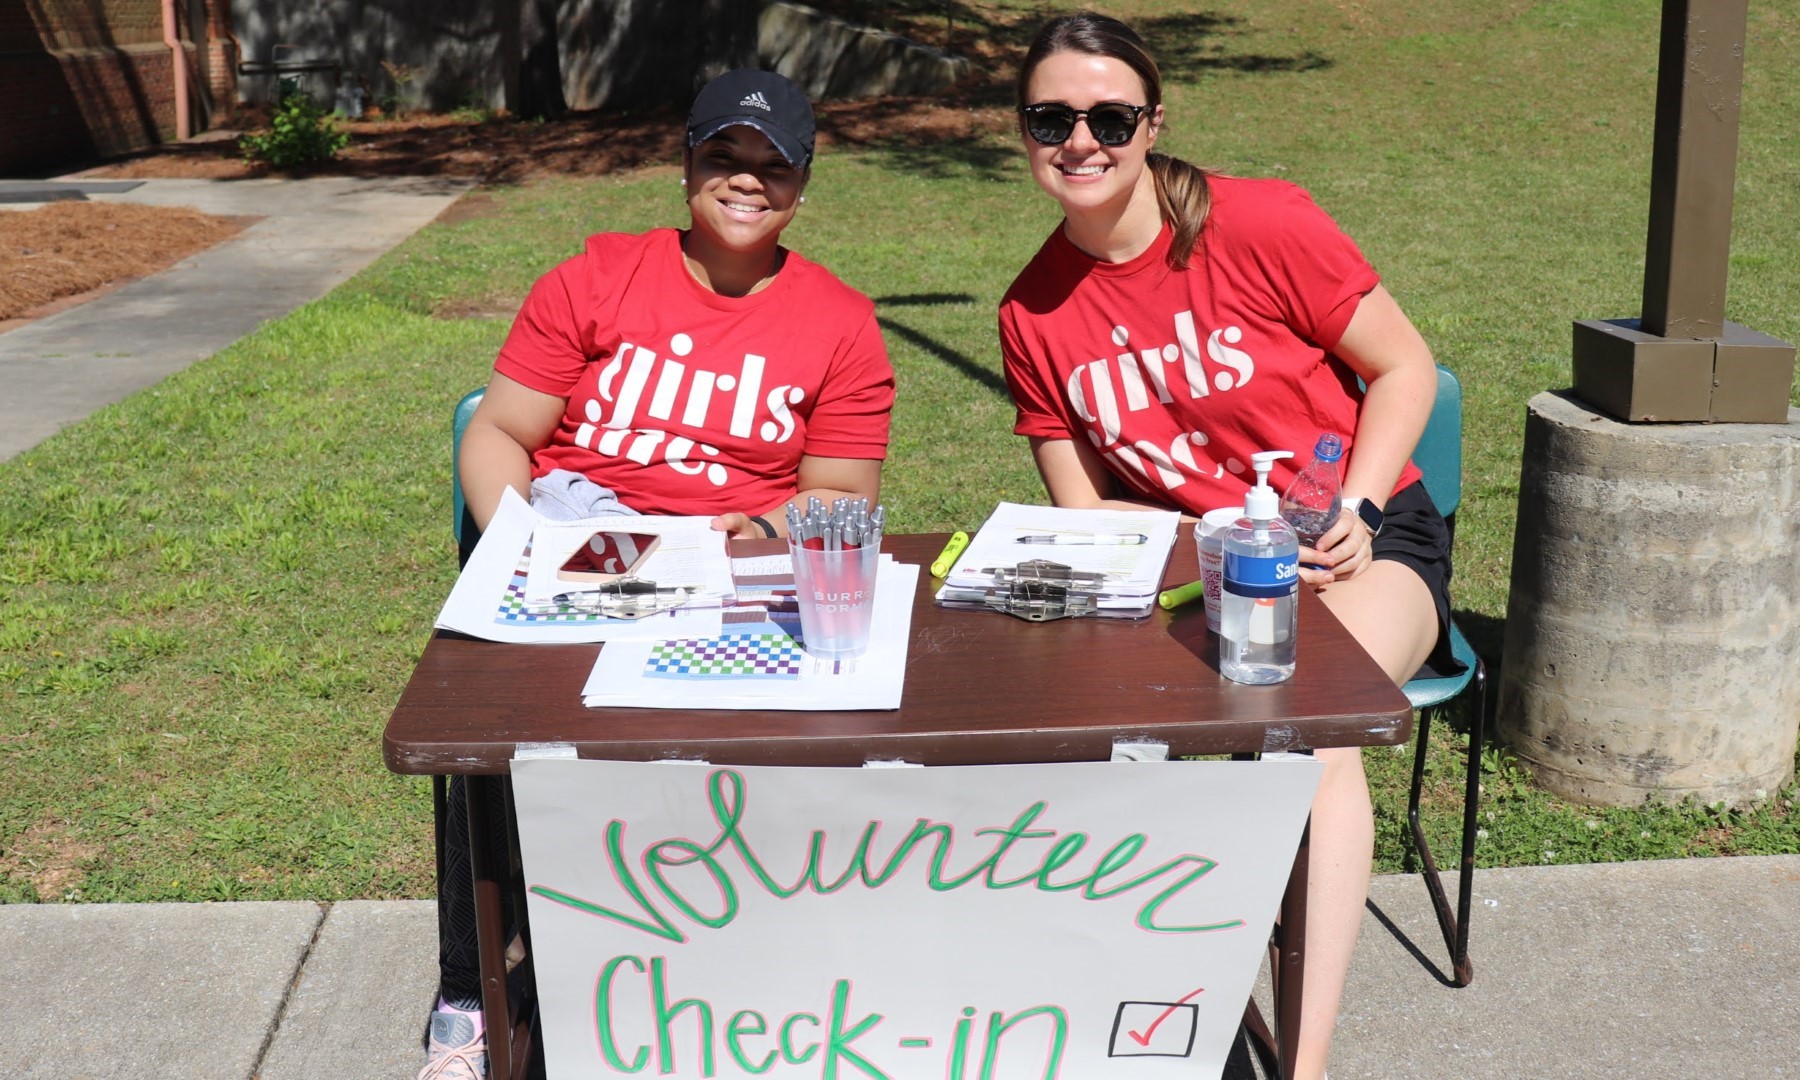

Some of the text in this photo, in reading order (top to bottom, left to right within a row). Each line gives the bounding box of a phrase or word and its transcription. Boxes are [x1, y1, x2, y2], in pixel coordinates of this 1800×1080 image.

[740, 99, 772, 112] adidas
[584, 333, 805, 443] girls
[1067, 310, 1255, 447] girls
[815, 602, 867, 613] FORM
[529, 768, 1247, 944] Volunteer
[593, 954, 1069, 1080] Check-in
